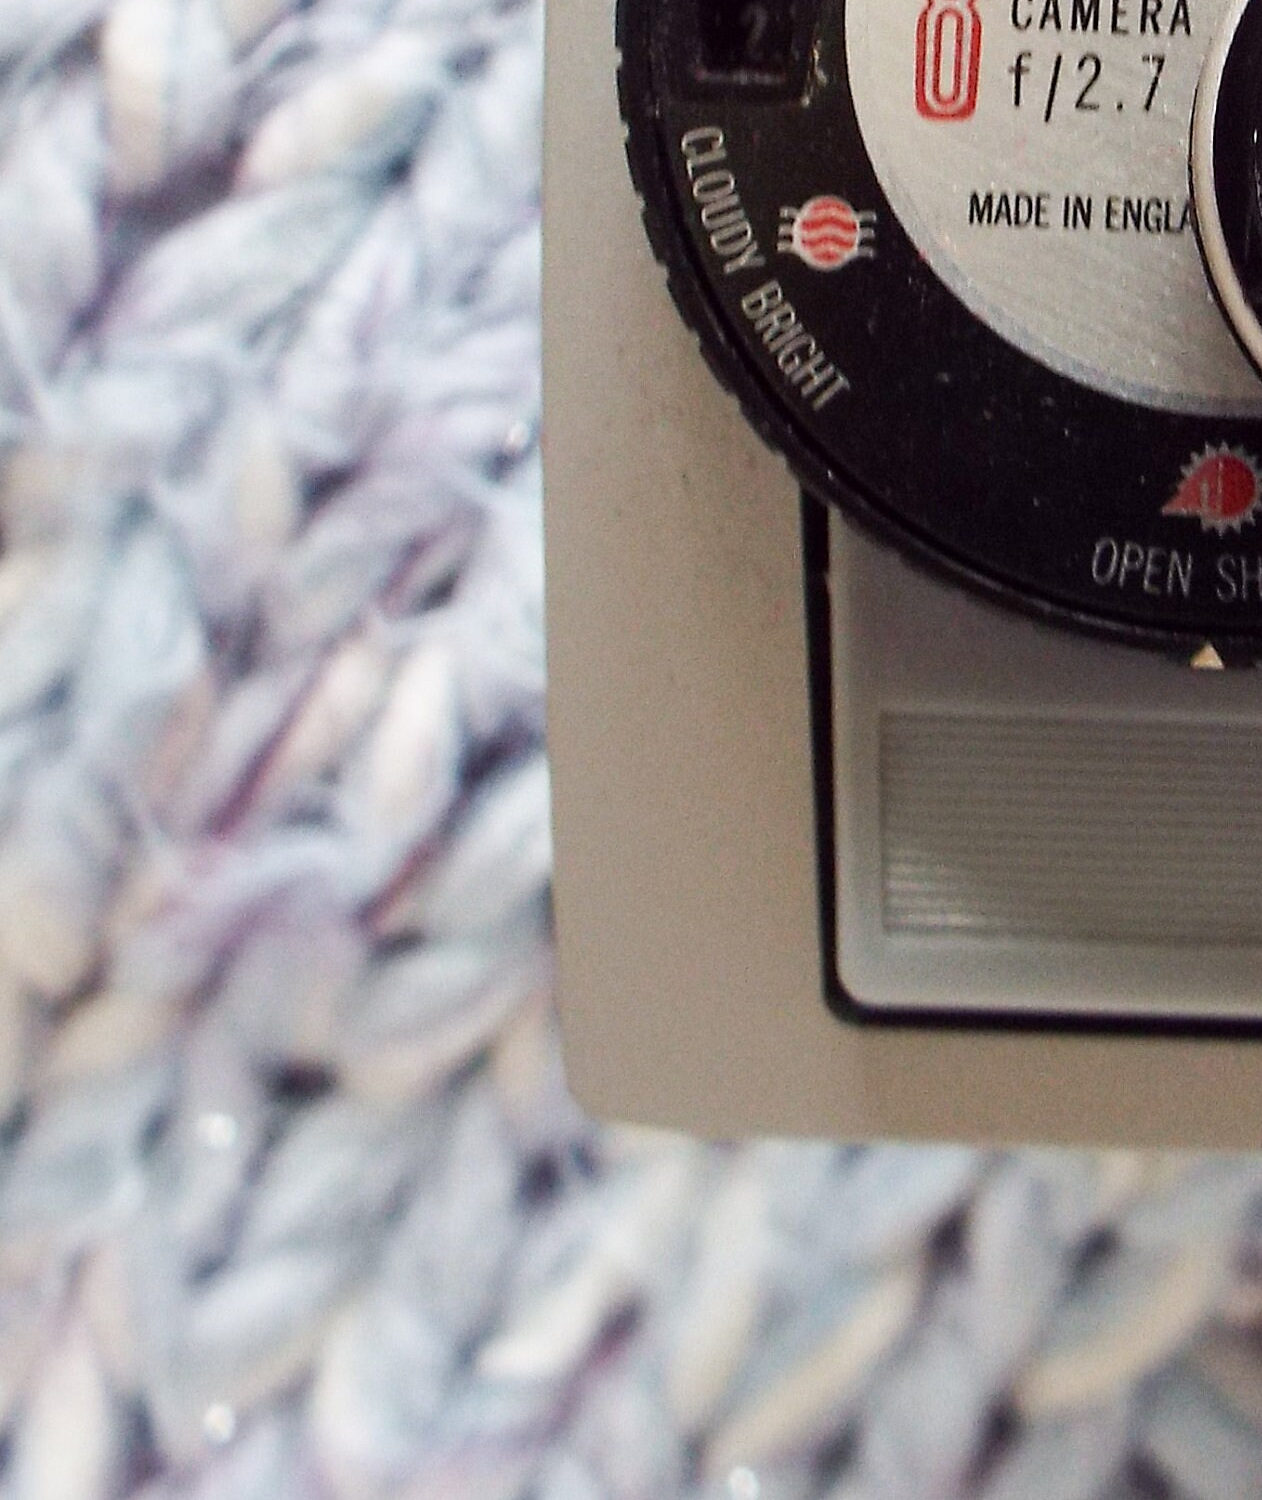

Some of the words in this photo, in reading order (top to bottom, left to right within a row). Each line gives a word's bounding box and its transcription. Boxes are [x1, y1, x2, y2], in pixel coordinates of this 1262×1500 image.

[1007, 51, 1166, 124] f/2.7
[968, 191, 1051, 230] MADE
[1062, 194, 1093, 231] IN
[681, 126, 766, 276] CLOUDY
[741, 279, 851, 412] BRIGHT
[1091, 536, 1193, 598] OPEN
